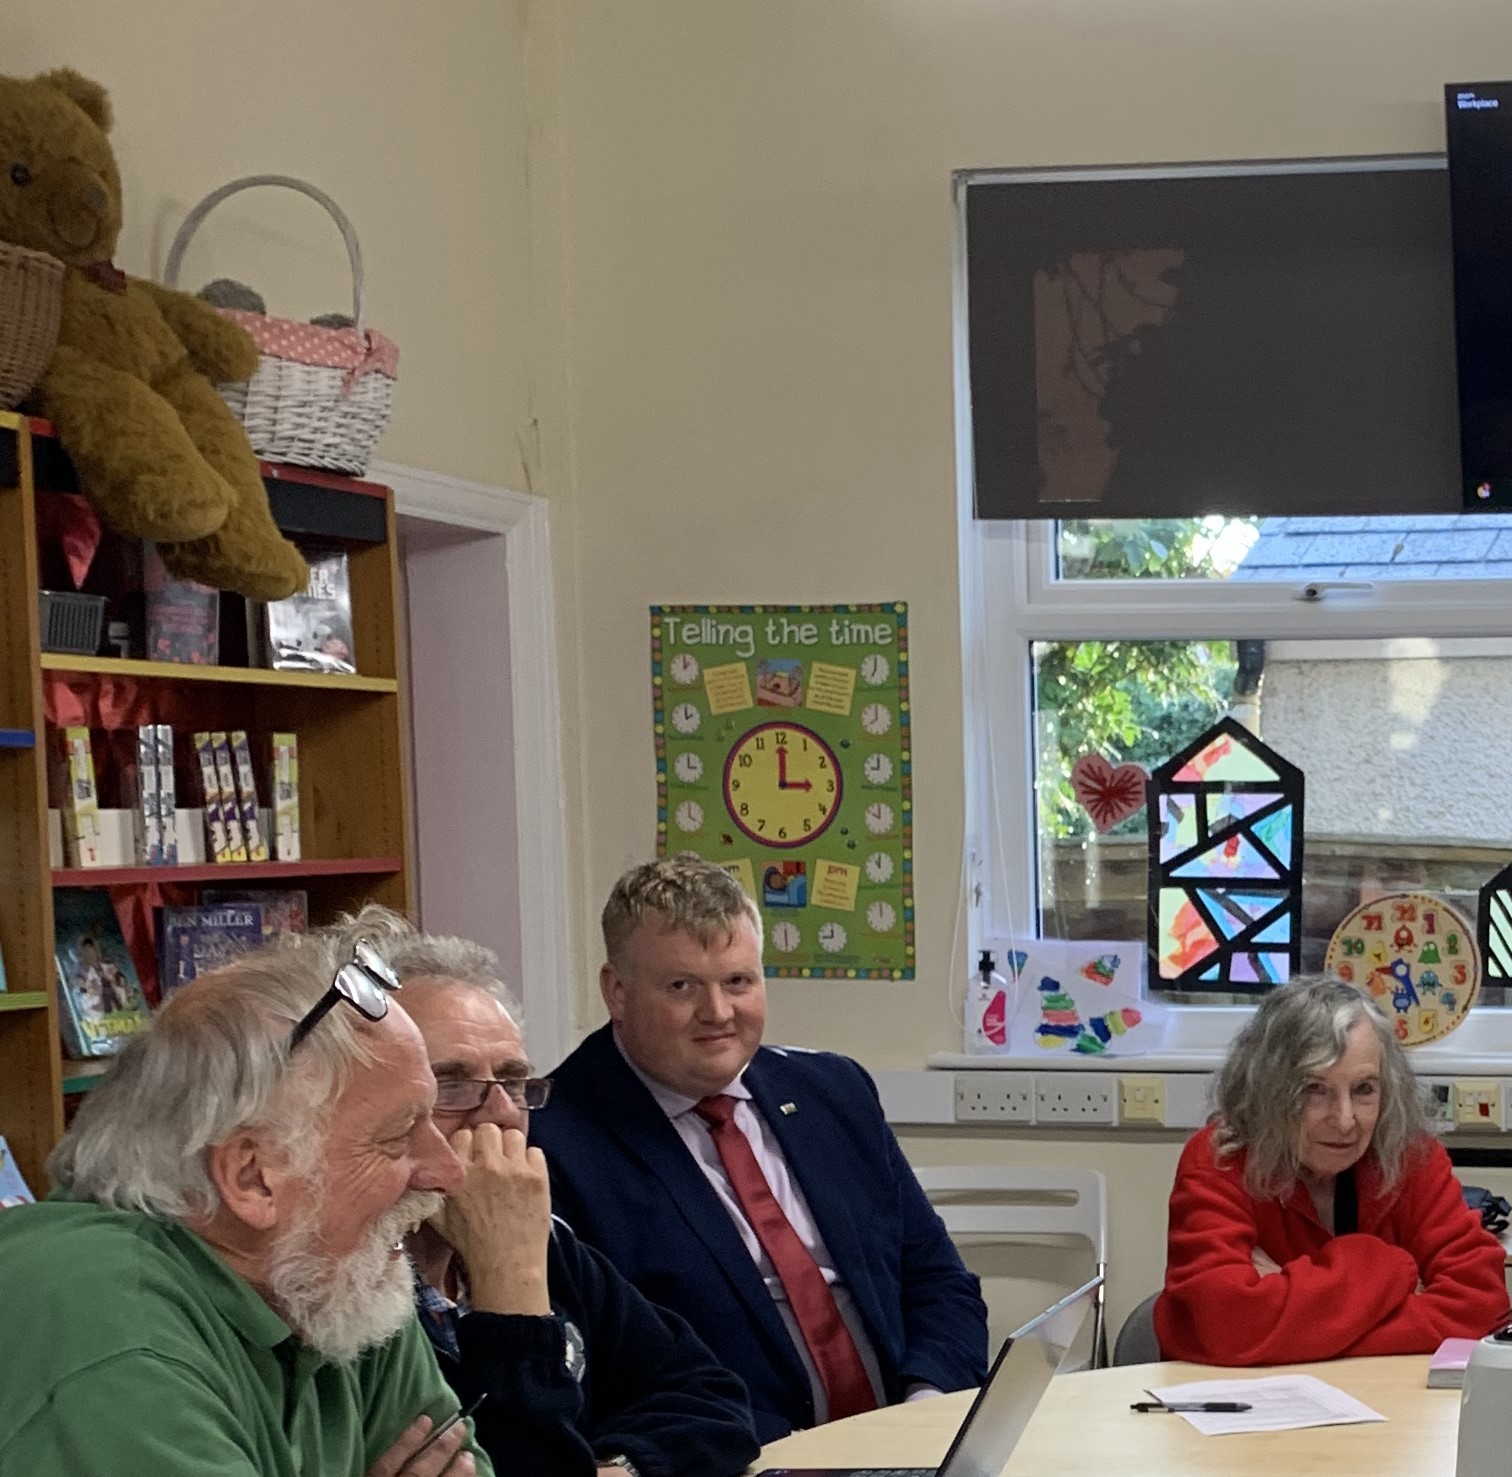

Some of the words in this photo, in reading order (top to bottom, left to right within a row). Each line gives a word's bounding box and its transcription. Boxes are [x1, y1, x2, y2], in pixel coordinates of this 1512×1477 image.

[1457, 100, 1499, 110] Workplace
[663, 617, 756, 658] Telling
[764, 618, 818, 646] the
[829, 618, 893, 646] time
[756, 737, 766, 750] 11
[775, 732, 788, 746] 12
[802, 738, 808, 751] 1
[738, 754, 752, 768] 10
[818, 756, 827, 768] 2
[732, 779, 740, 791] 9
[827, 779, 834, 792] 3
[740, 802, 749, 816] 8
[818, 802, 827, 816] 4
[758, 819, 766, 832] 7
[803, 819, 812, 832] 5
[778, 827, 786, 838] 6
[201, 910, 254, 927] MILLER
[1423, 913, 1436, 934] 1
[1454, 963, 1467, 986] 3
